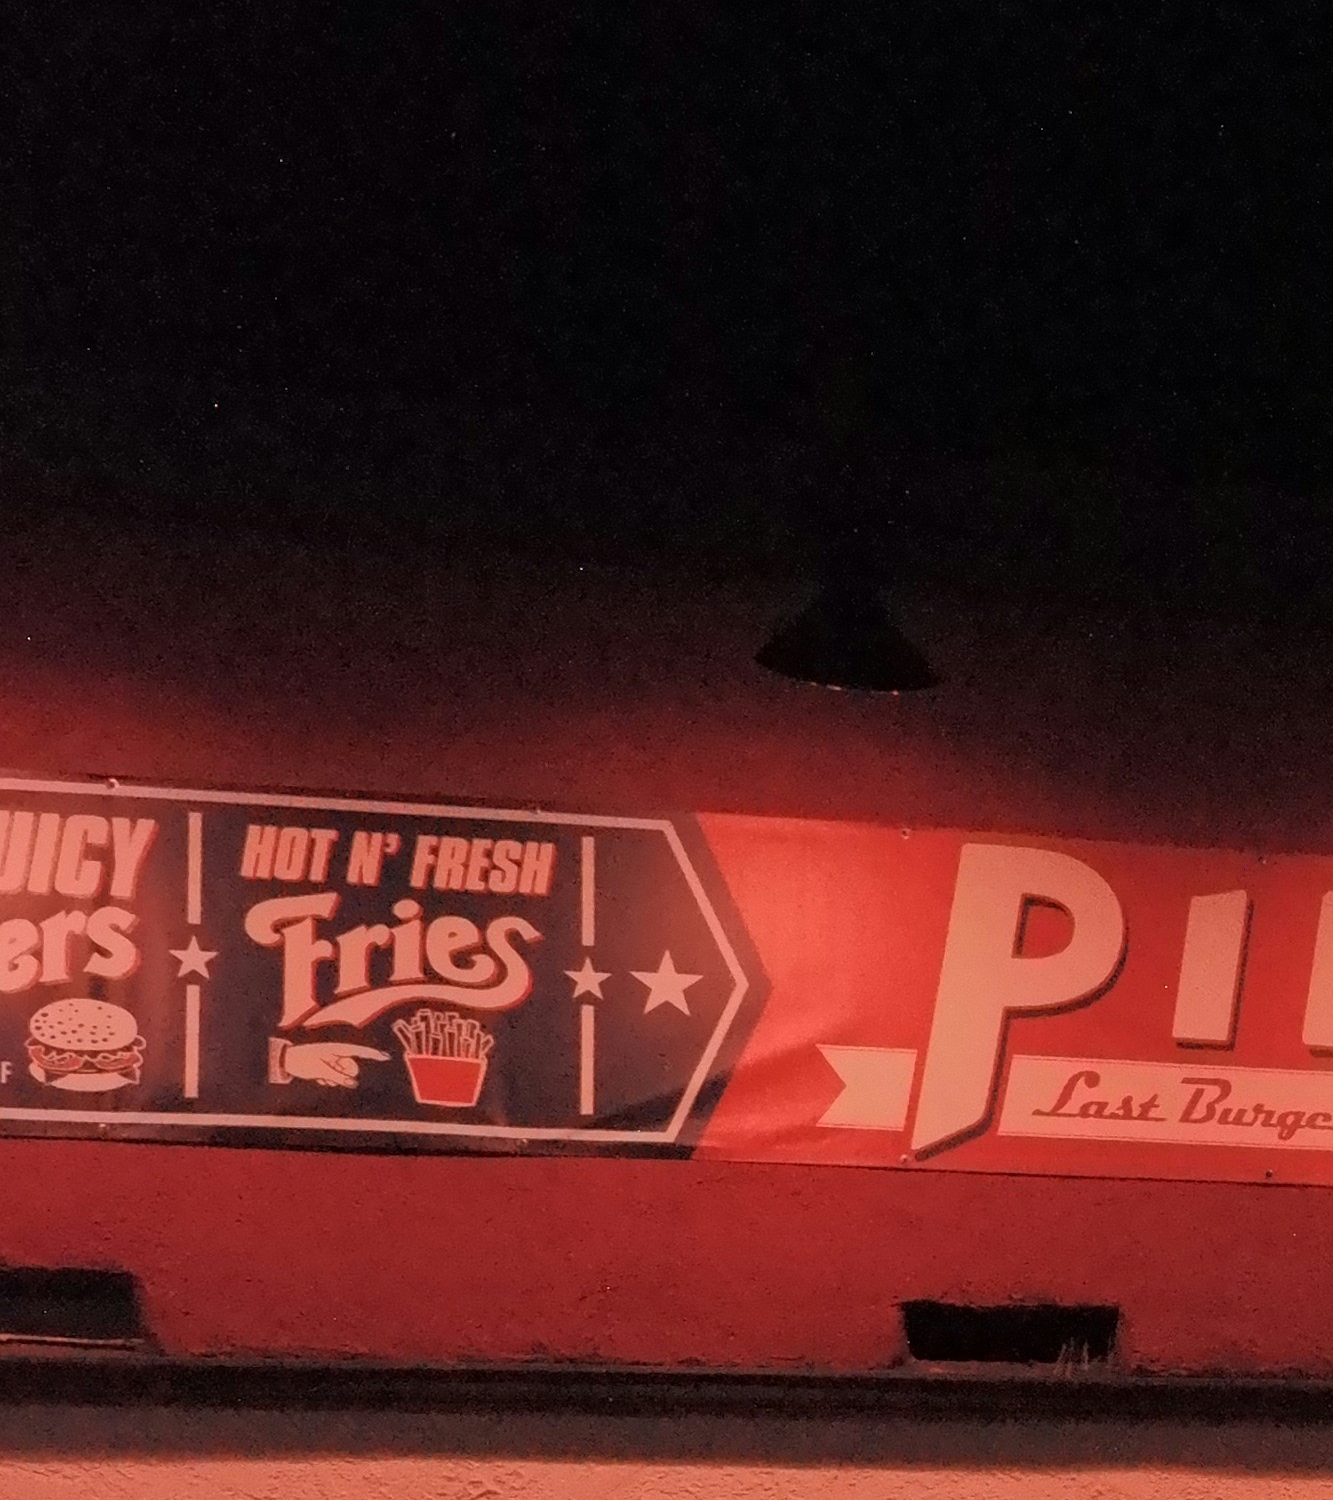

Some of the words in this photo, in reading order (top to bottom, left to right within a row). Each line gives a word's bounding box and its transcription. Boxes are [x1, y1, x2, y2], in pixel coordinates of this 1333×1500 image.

[240, 825, 340, 883] HOT
[347, 831, 400, 886] N'
[410, 834, 557, 896] FRESH
[244, 892, 545, 1030] Fries
[1032, 1070, 1166, 1122] Last
